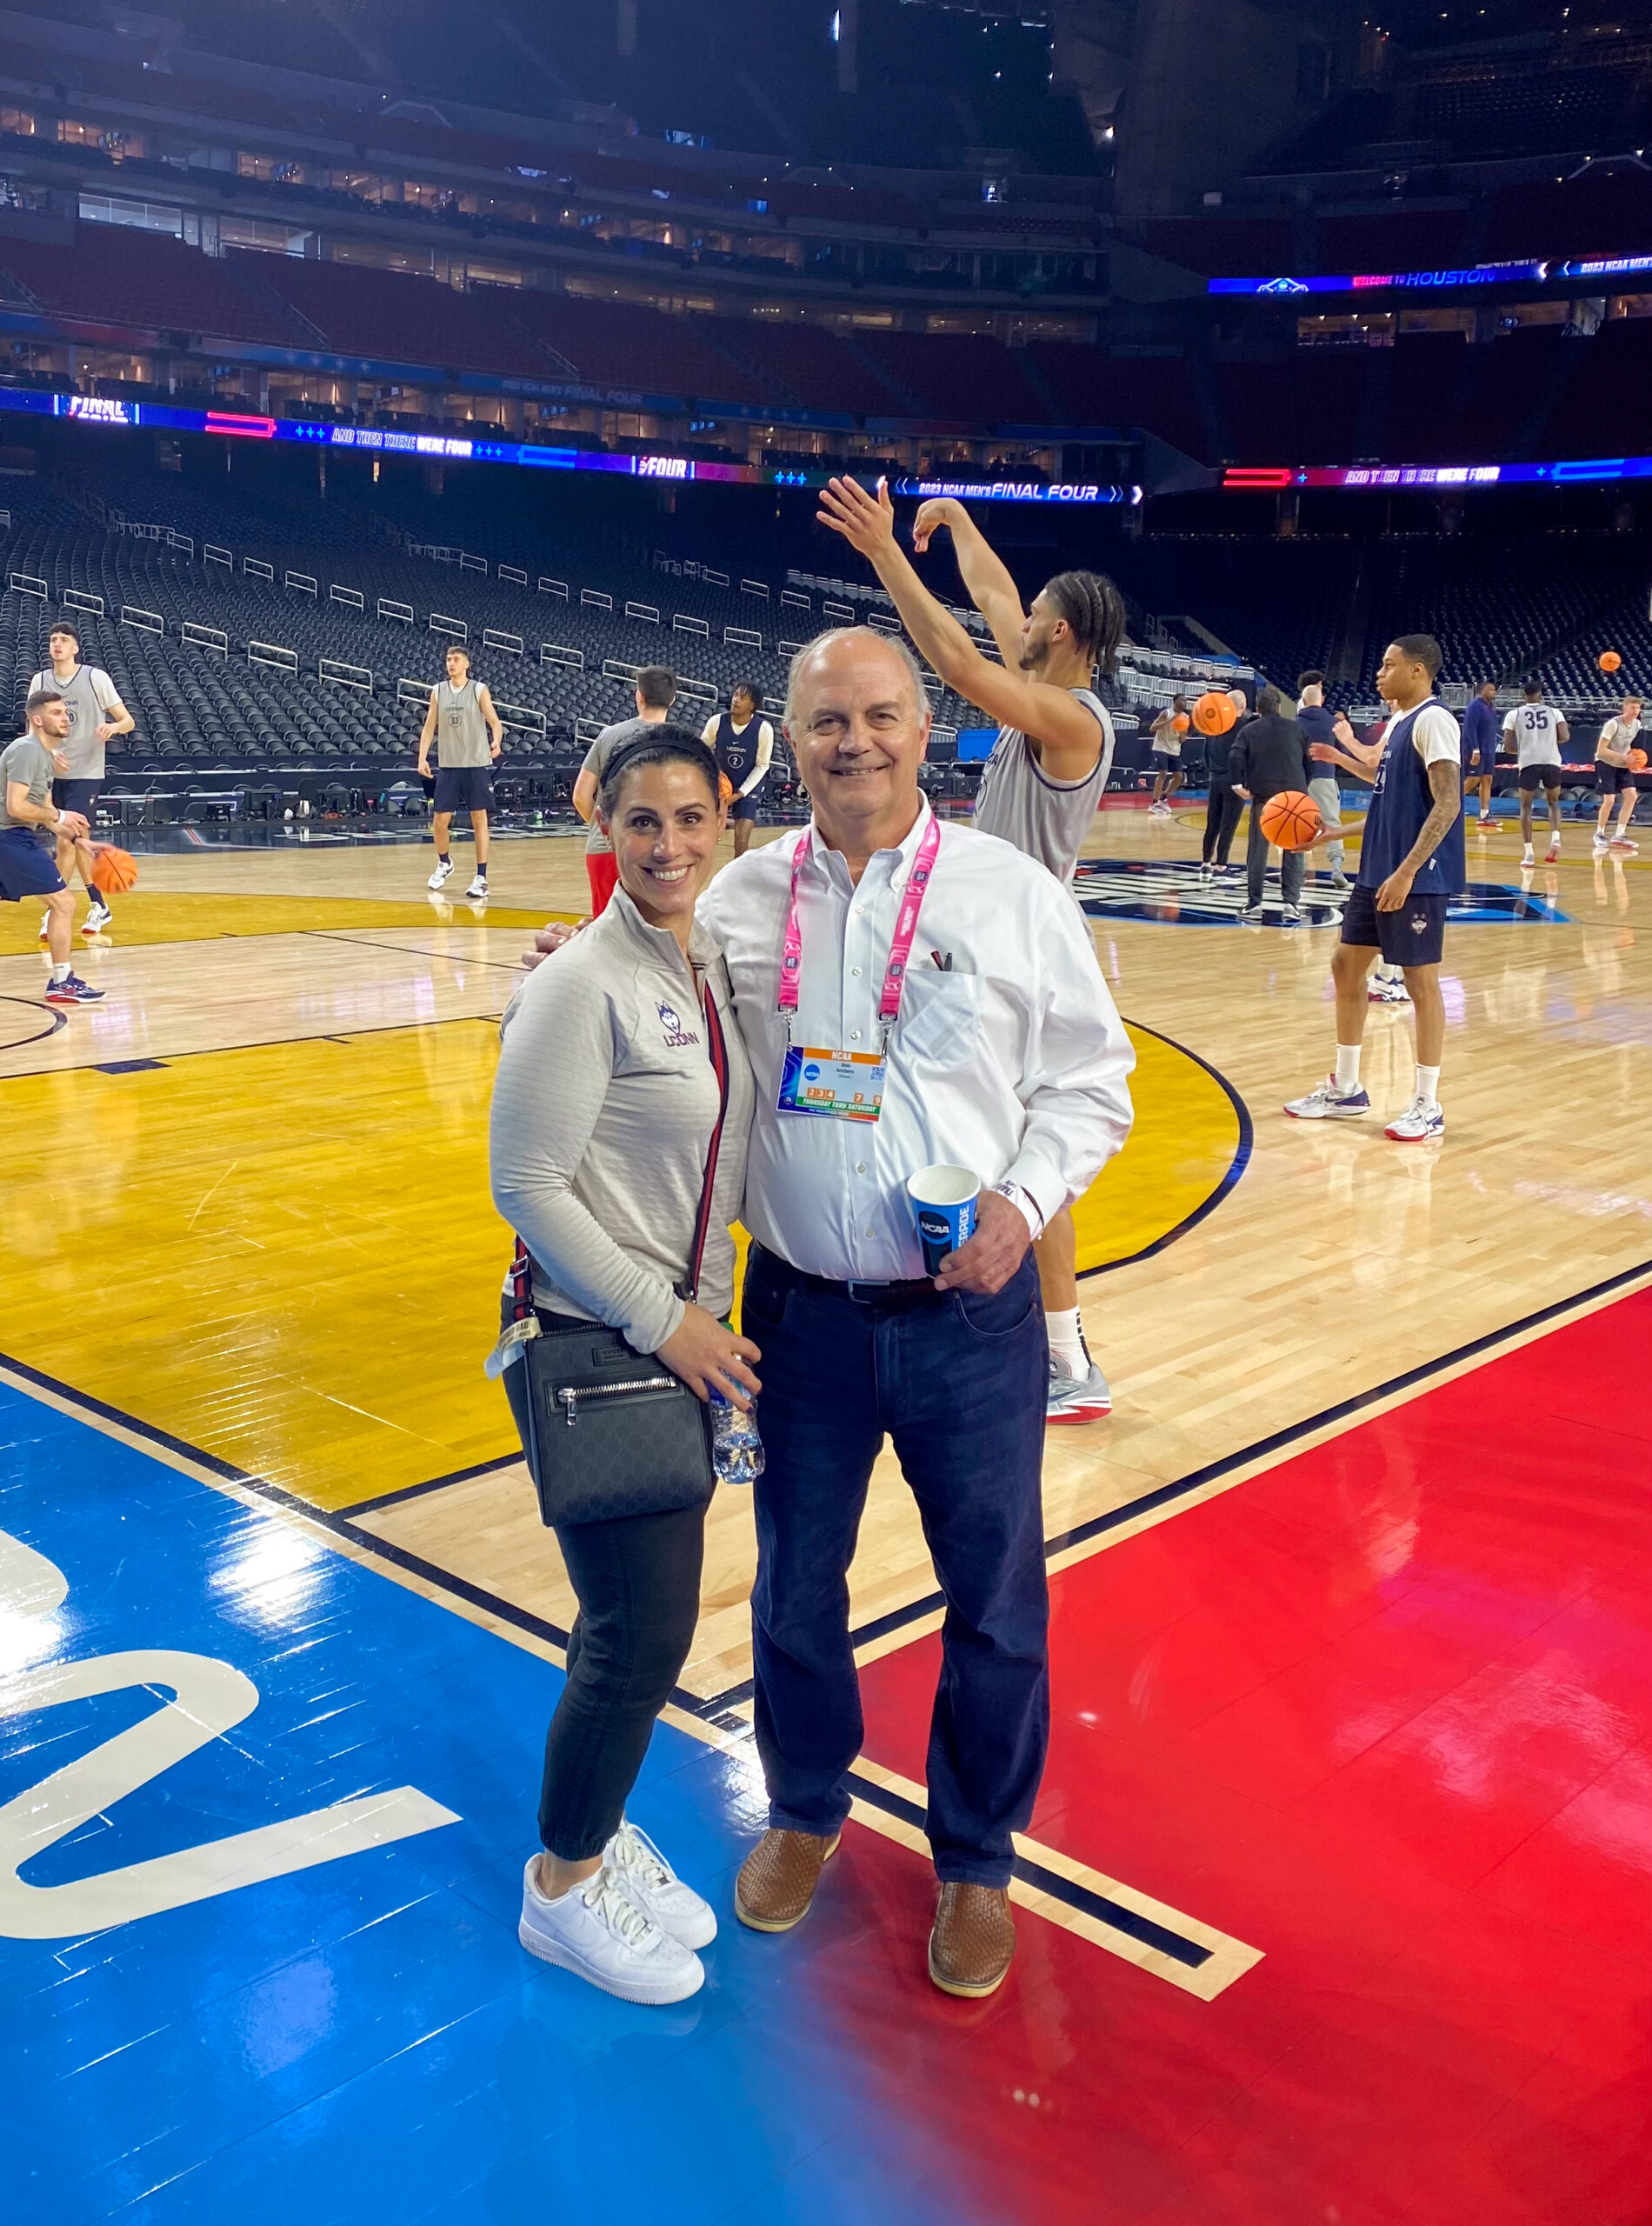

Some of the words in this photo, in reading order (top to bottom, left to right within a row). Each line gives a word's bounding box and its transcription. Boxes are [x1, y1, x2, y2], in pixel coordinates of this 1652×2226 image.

[1581, 262, 1604, 273] 2023
[1605, 259, 1629, 271] NCAA
[1629, 257, 1652, 270] MEN'
[1353, 276, 1392, 287] WELCOME
[1406, 270, 1496, 286] HOUSTON
[564, 385, 603, 402] FINAL
[606, 390, 643, 405] FOUR
[71, 396, 124, 417] FINAL
[331, 428, 354, 443] AND
[356, 430, 383, 446] THEN
[384, 433, 416, 450] THERE
[416, 437, 445, 453] WERE
[445, 439, 473, 457] FOUR
[648, 457, 687, 477] FOUR
[1345, 470, 1370, 483] AND
[1370, 470, 1400, 483] THEN
[1401, 469, 1436, 482] THERE
[1436, 468, 1469, 482] WERE
[1469, 466, 1500, 481] FOUR
[918, 483, 941, 495] 2023
[943, 484, 965, 496] NCAA
[965, 485, 991, 497] MEN'S
[991, 483, 1042, 499] FINAL
[1048, 484, 1099, 501] FOUR
[1524, 710, 1549, 730] 35
[732, 756, 738, 766] 2
[663, 1031, 700, 1048] UCONN
[832, 1051, 852, 1061] NCAA
[803, 1097, 831, 1108] THURSDAY
[831, 1100, 847, 1109] THRU
[847, 1103, 877, 1113] SATURDAY
[922, 1220, 949, 1234] NCAA
